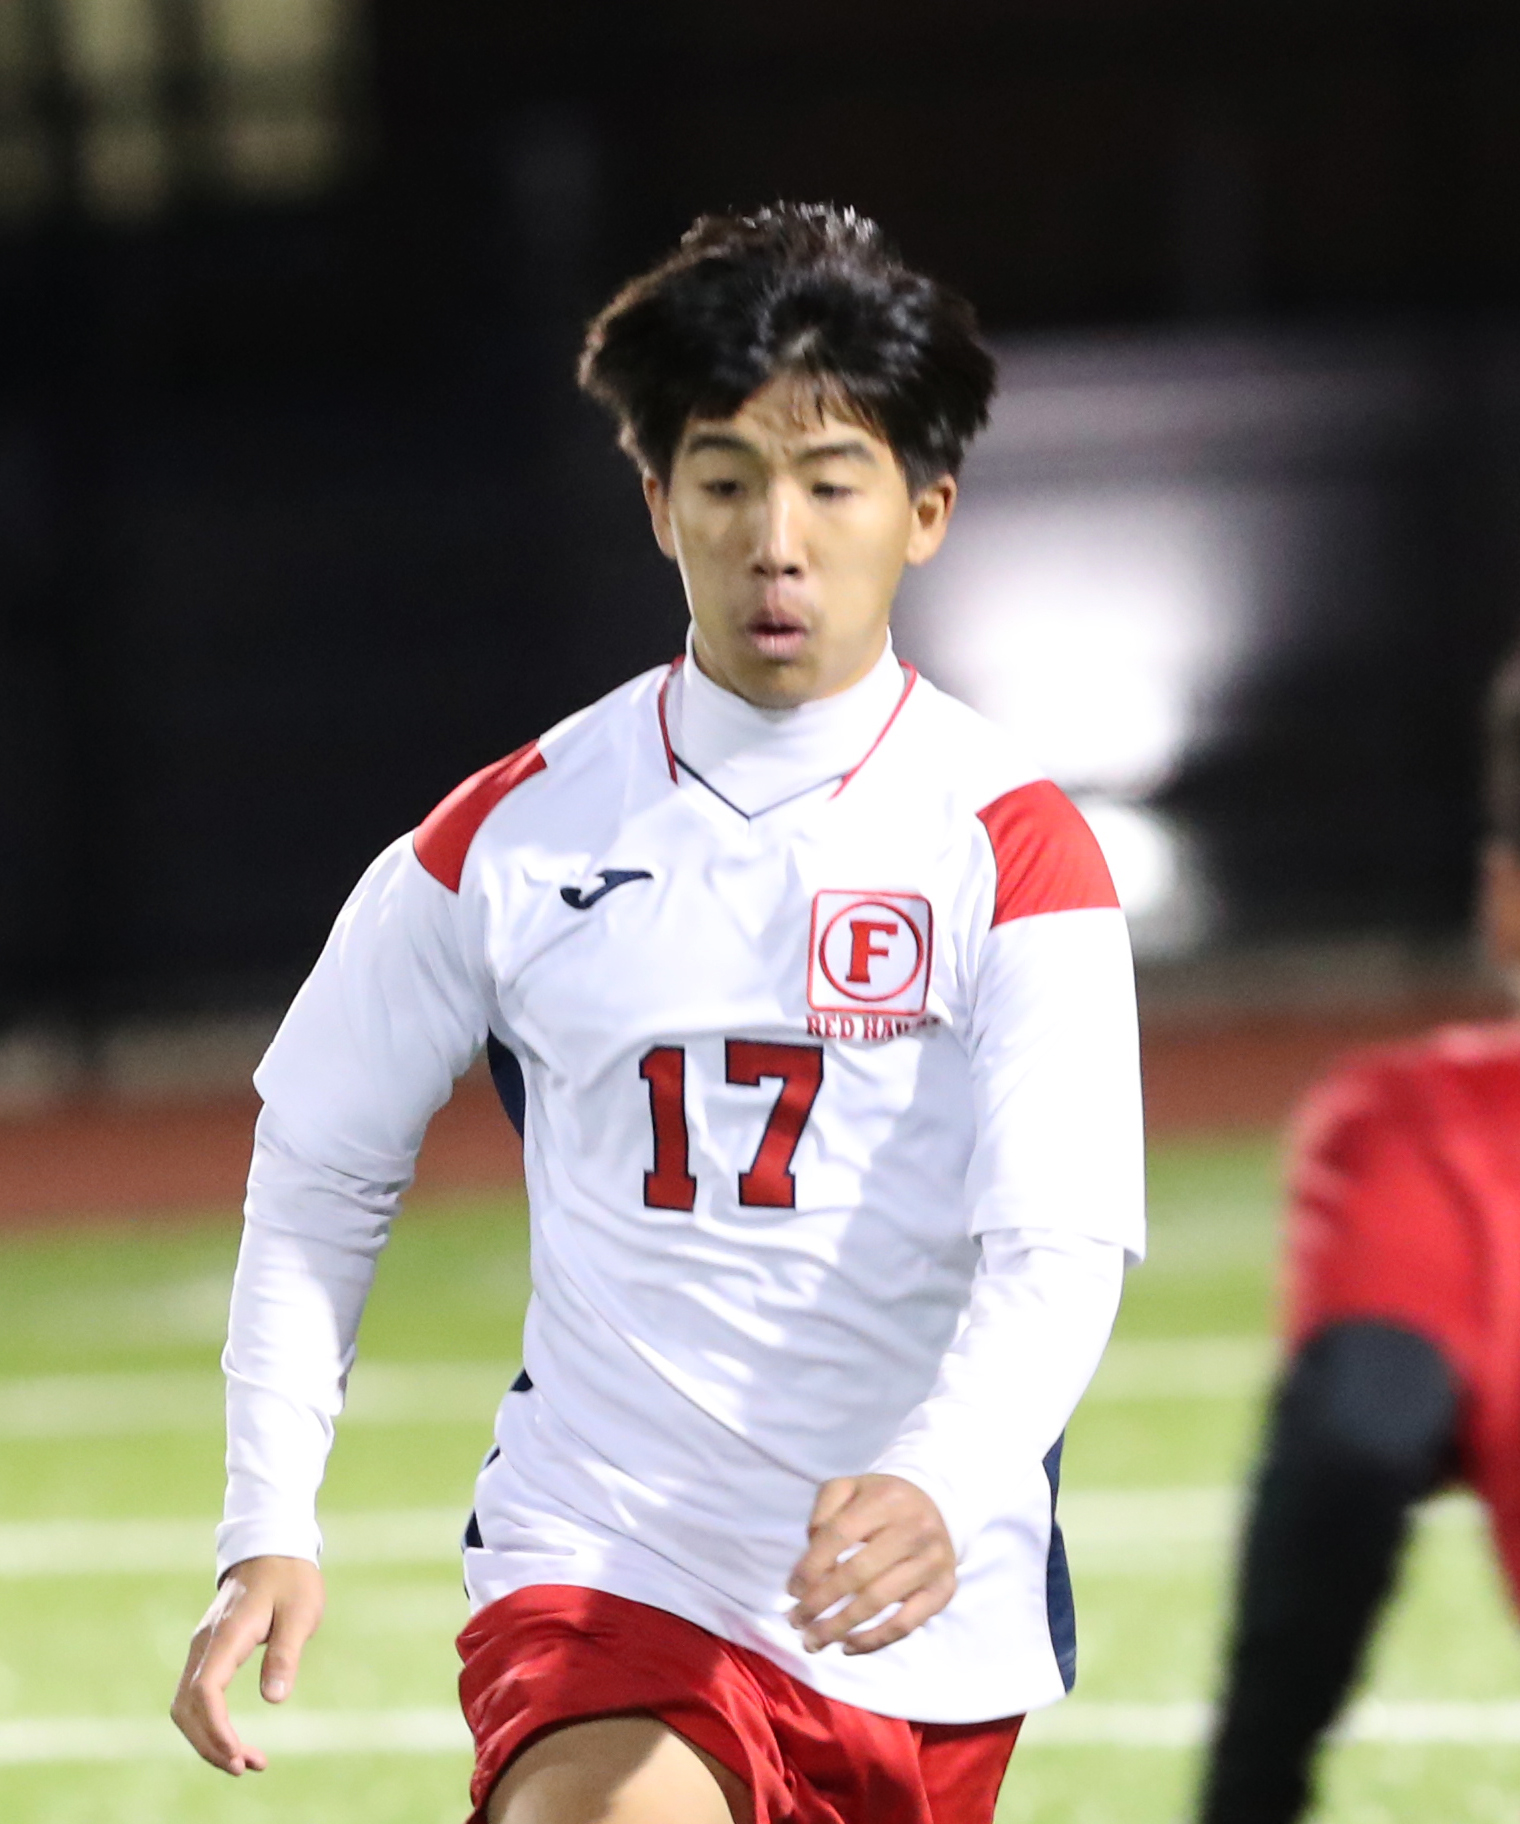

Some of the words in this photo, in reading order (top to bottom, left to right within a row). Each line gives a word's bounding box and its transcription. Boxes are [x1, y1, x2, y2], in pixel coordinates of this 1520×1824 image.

[845, 919, 898, 984] F
[806, 1013, 855, 1039] RED
[639, 1037, 824, 1212] 17
